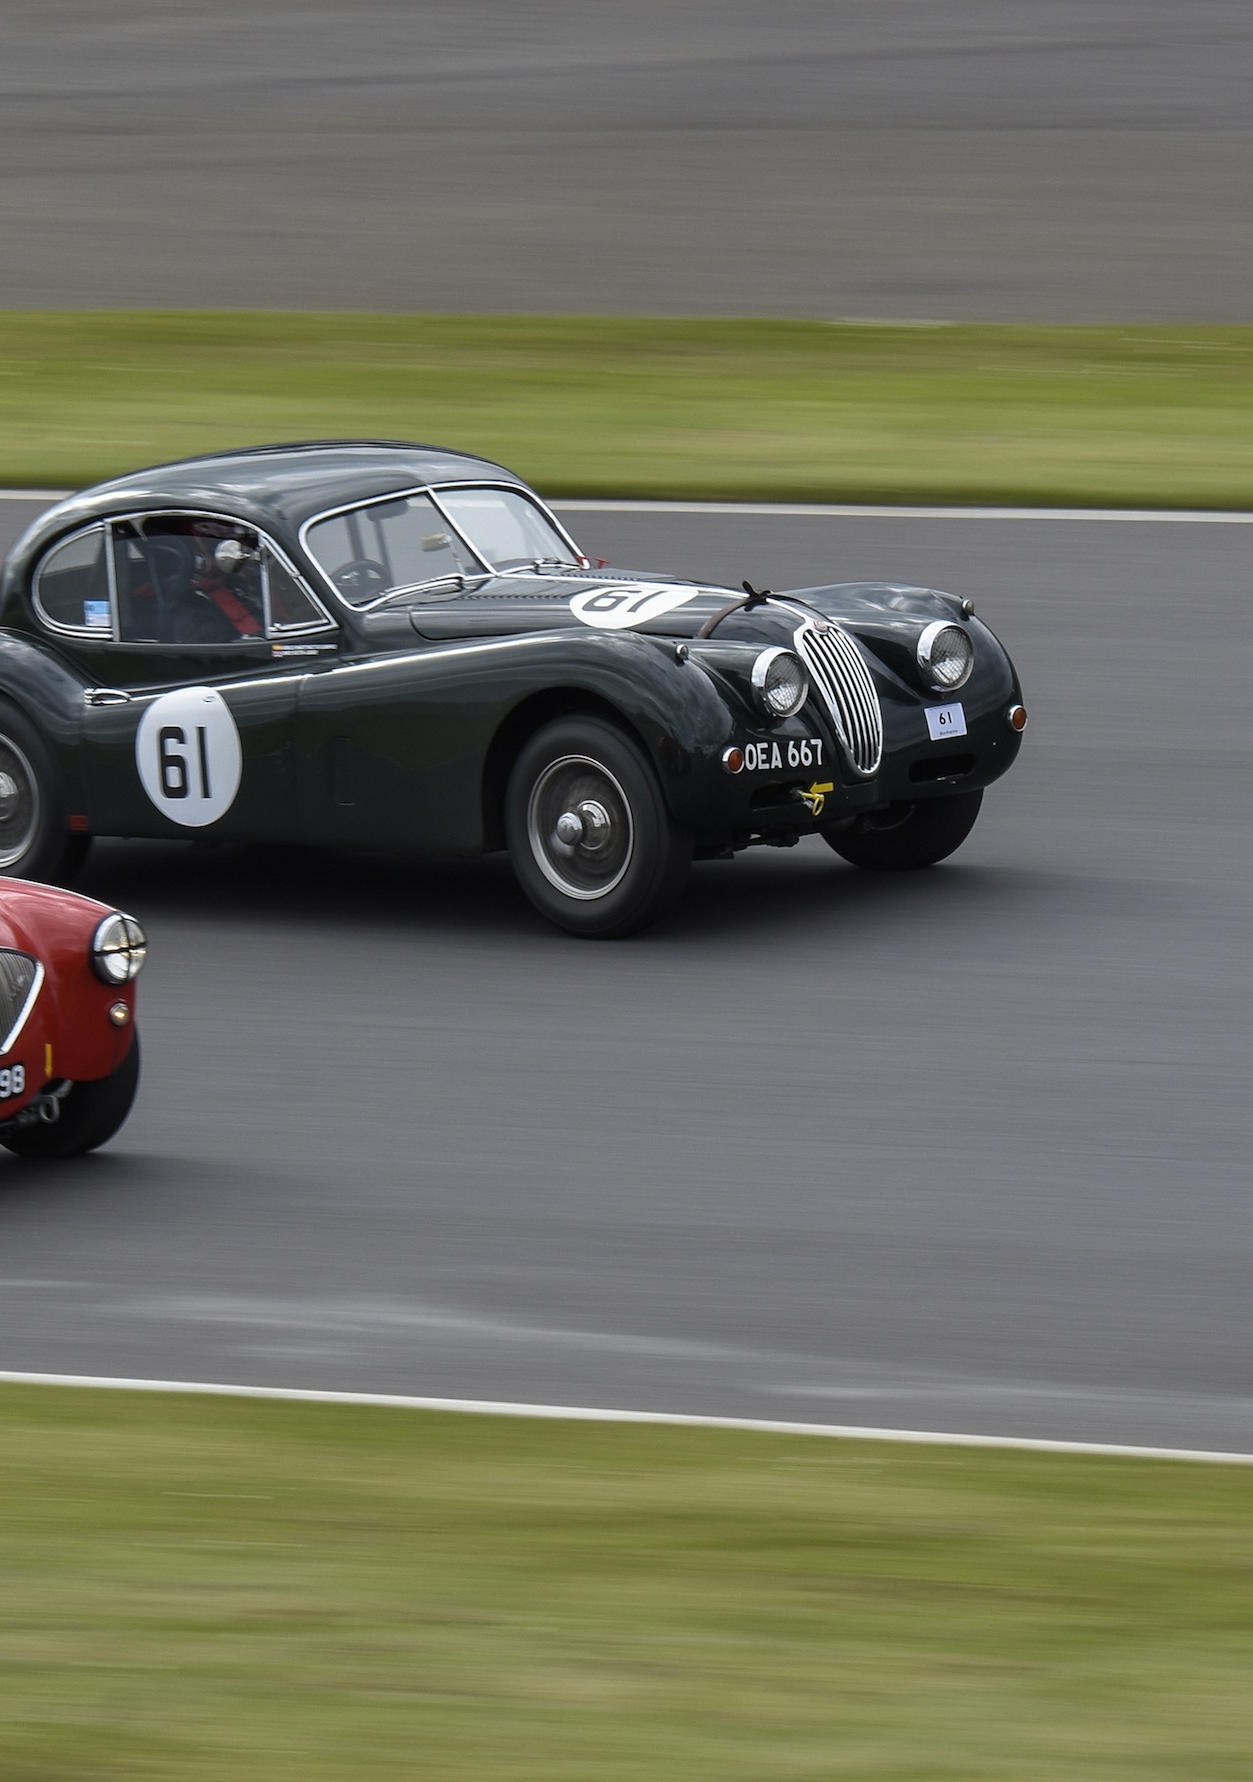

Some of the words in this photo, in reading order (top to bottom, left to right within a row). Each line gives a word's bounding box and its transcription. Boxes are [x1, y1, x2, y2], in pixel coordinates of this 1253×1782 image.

[581, 588, 669, 613] 61
[939, 711, 952, 725] 61
[158, 726, 212, 799] 61
[745, 742, 783, 770] OEA
[787, 739, 823, 768] 667
